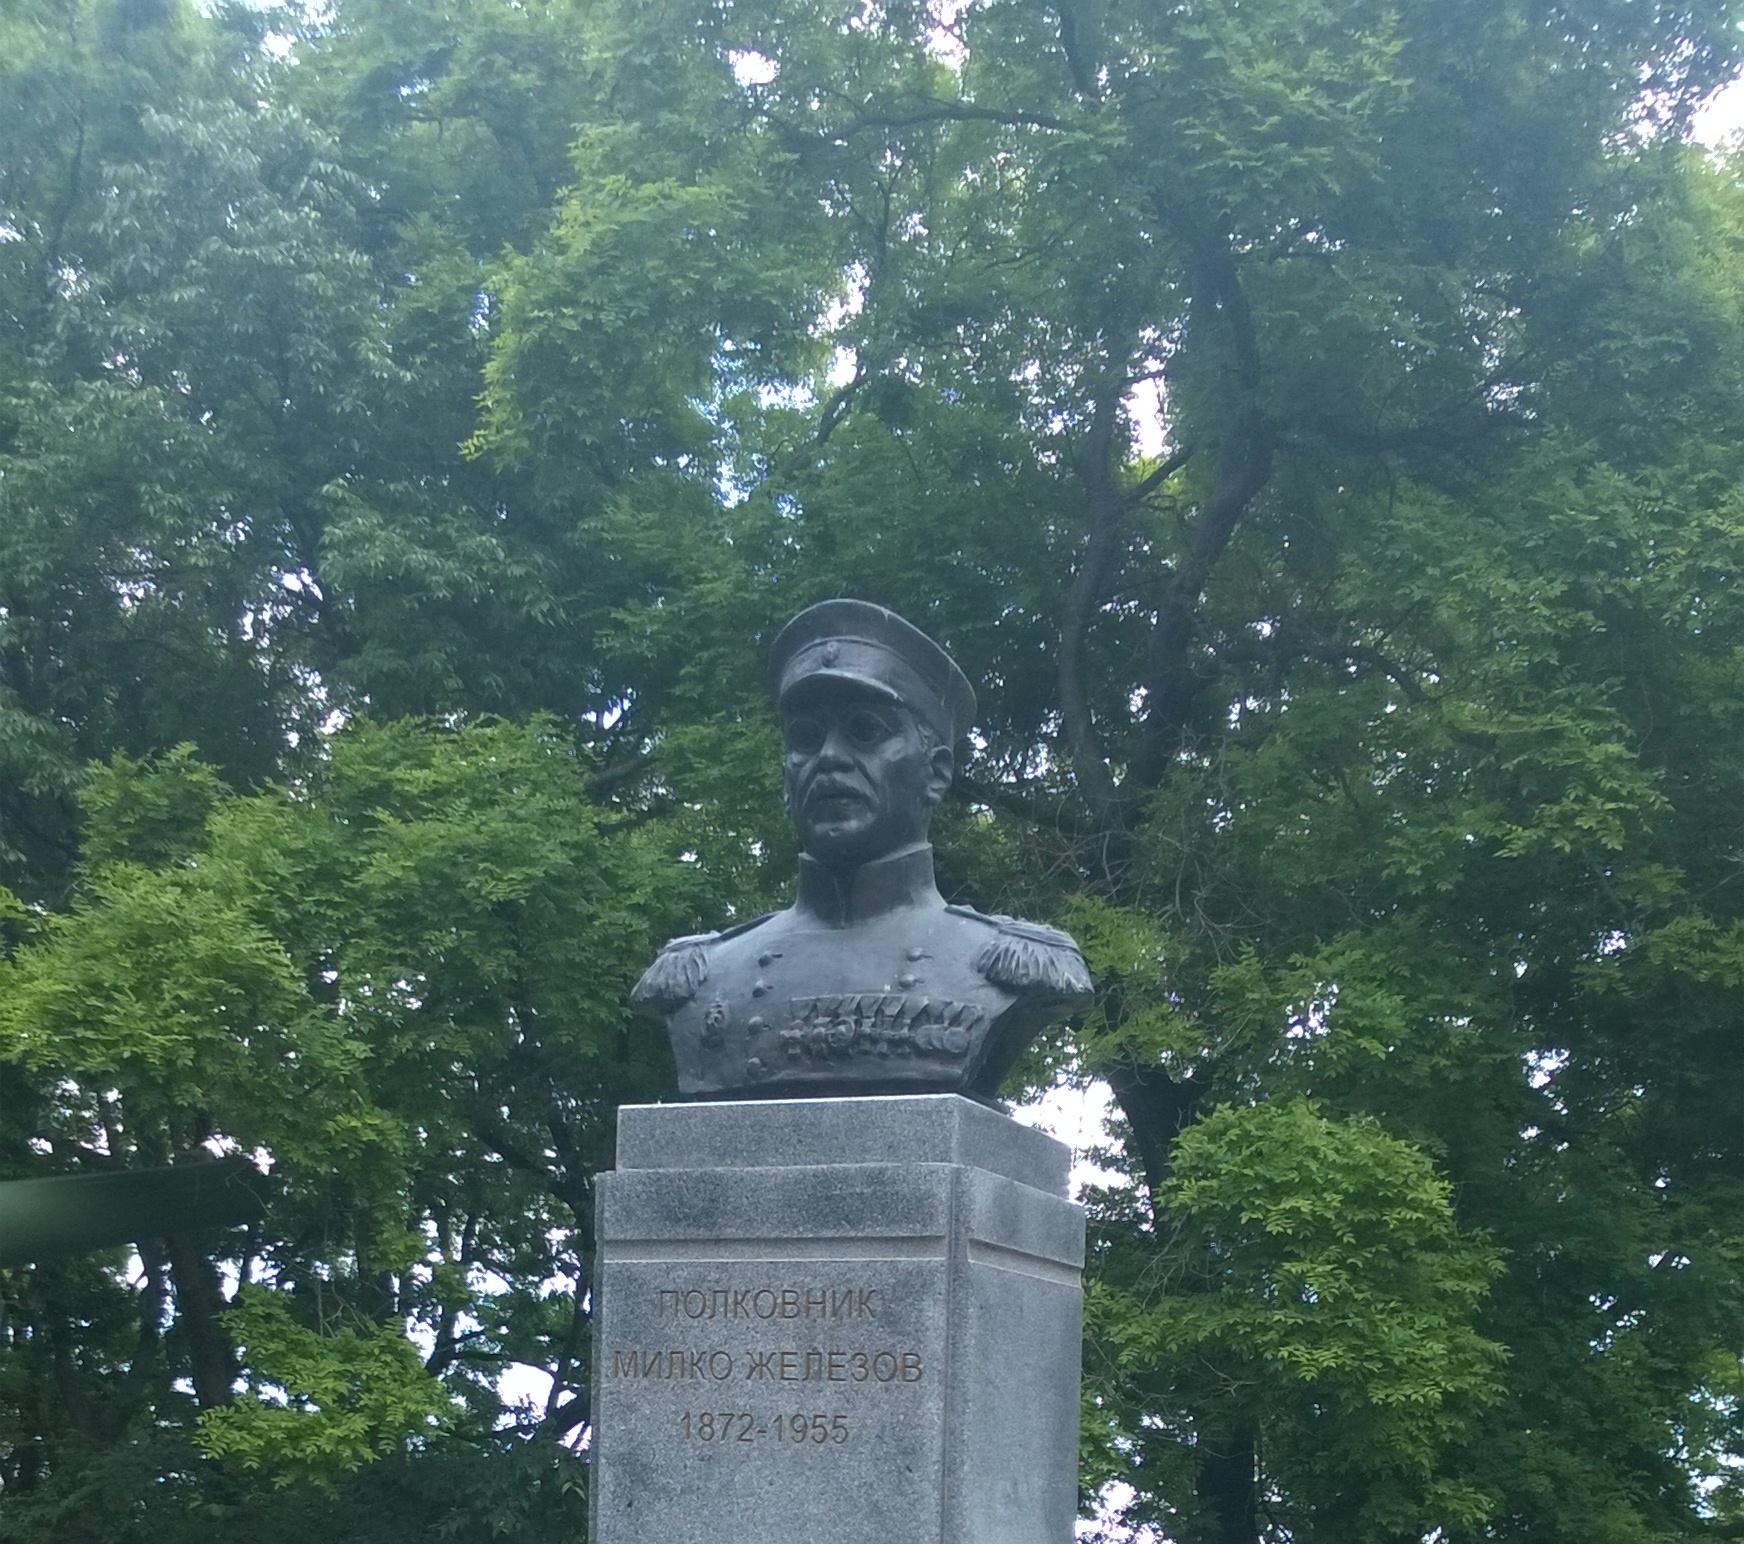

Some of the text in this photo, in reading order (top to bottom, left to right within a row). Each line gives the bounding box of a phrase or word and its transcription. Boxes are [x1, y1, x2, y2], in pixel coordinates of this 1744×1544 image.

[655, 1288, 878, 1320] ПОЛКОВНИК
[613, 1350, 924, 1383] МИЛКО ЖЕЛЕЗОВ
[680, 1411, 850, 1445] 1872-1955
